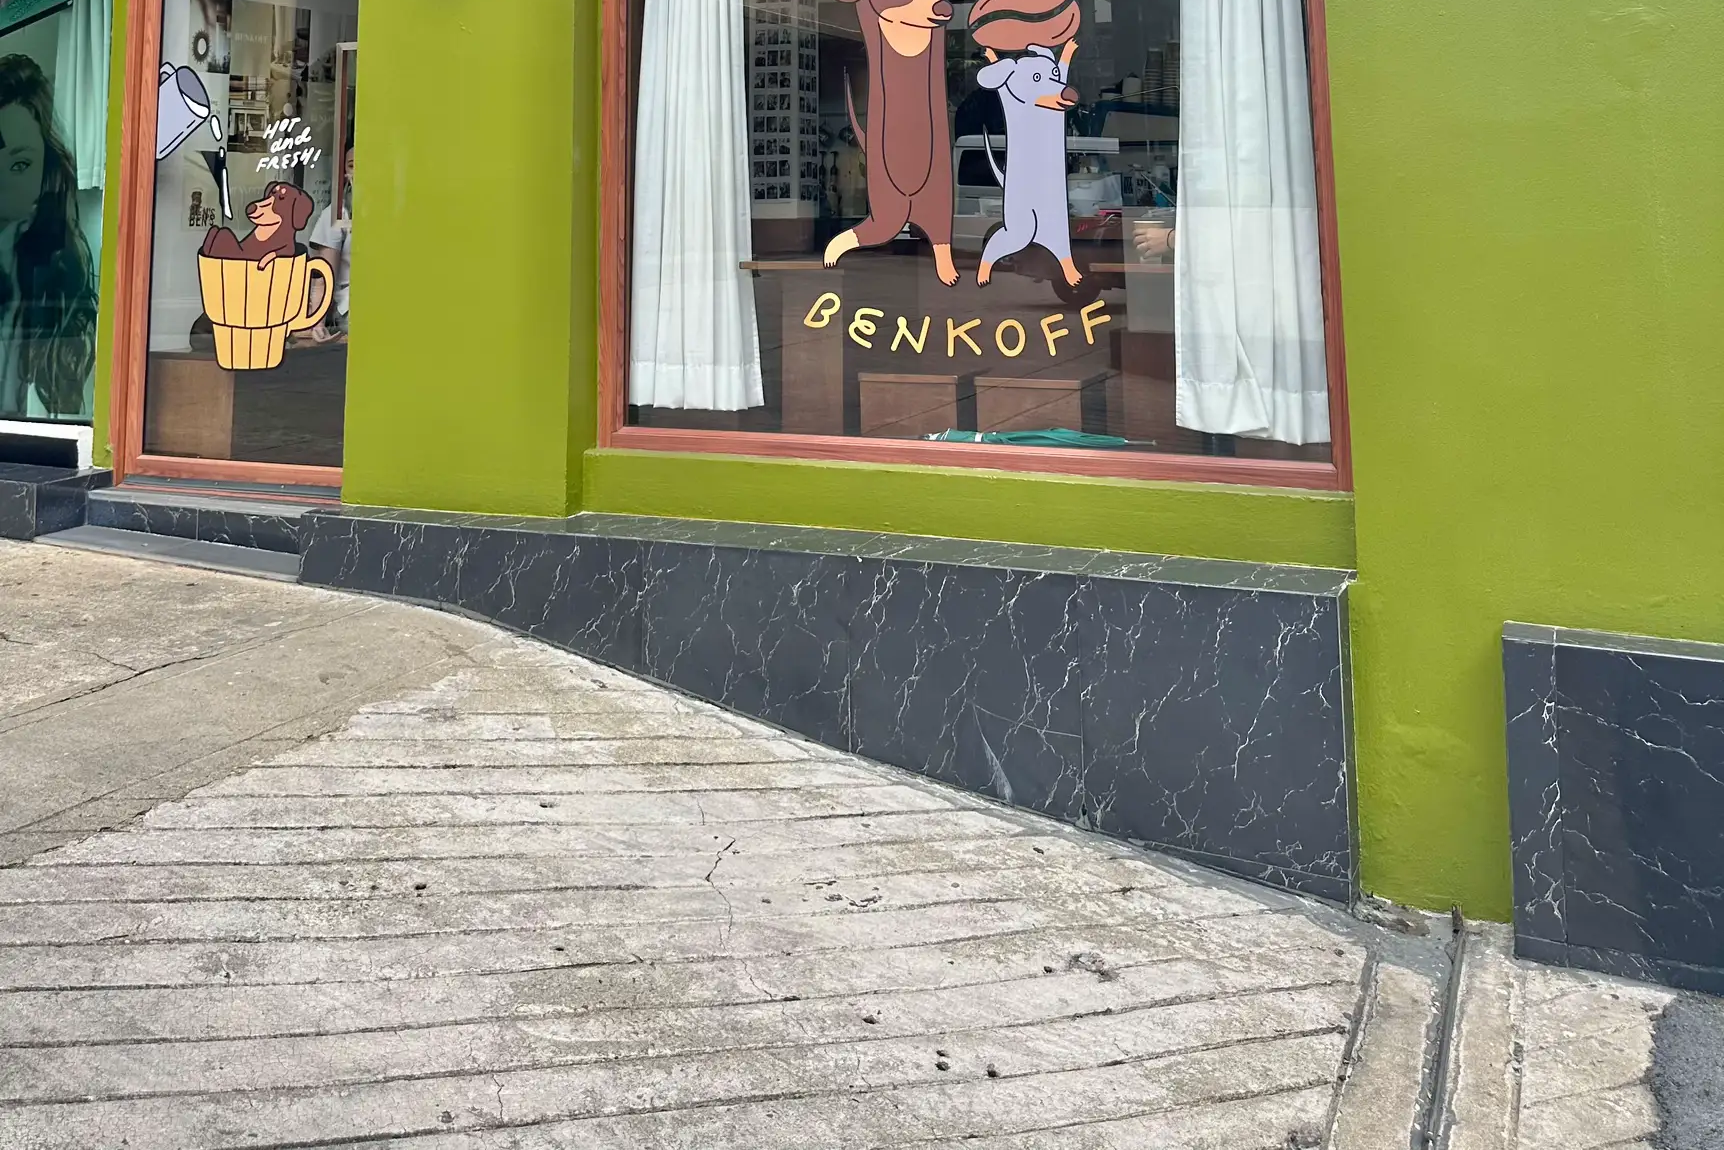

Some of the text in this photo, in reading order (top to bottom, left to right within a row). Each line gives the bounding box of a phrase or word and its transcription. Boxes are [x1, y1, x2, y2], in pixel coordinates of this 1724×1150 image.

[262, 116, 302, 139] HOT
[270, 126, 312, 153] and
[255, 146, 322, 173] FRESH!
[803, 291, 1112, 358] BENKOFF
